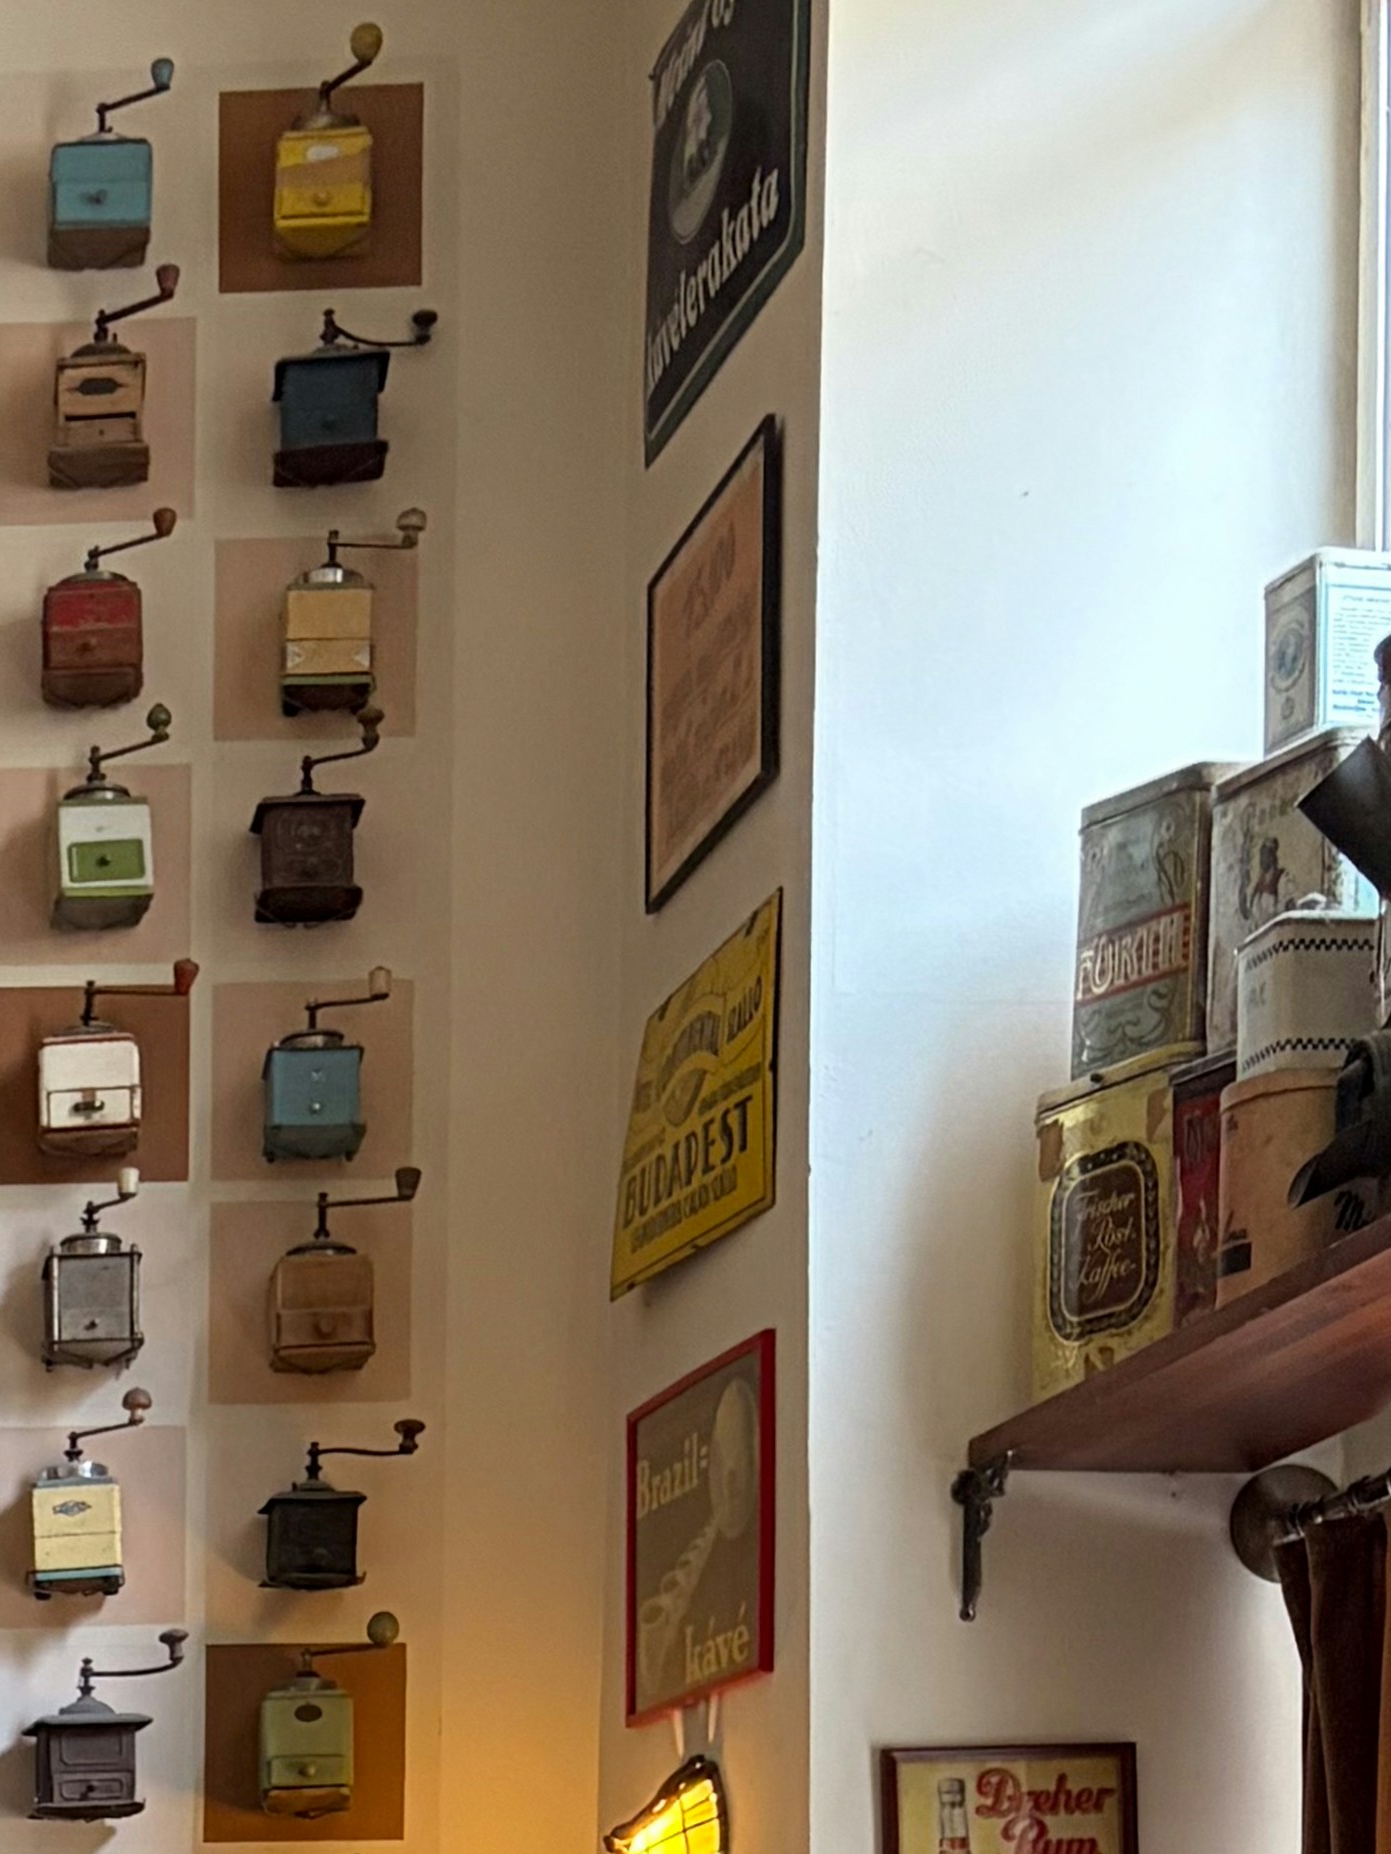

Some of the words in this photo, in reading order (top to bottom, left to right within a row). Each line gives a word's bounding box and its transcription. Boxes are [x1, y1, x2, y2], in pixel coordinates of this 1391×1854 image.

[623, 1095, 753, 1228] BUDAPEST
[684, 1602, 751, 1684] kávé
[974, 1767, 1117, 1819] Dreher
